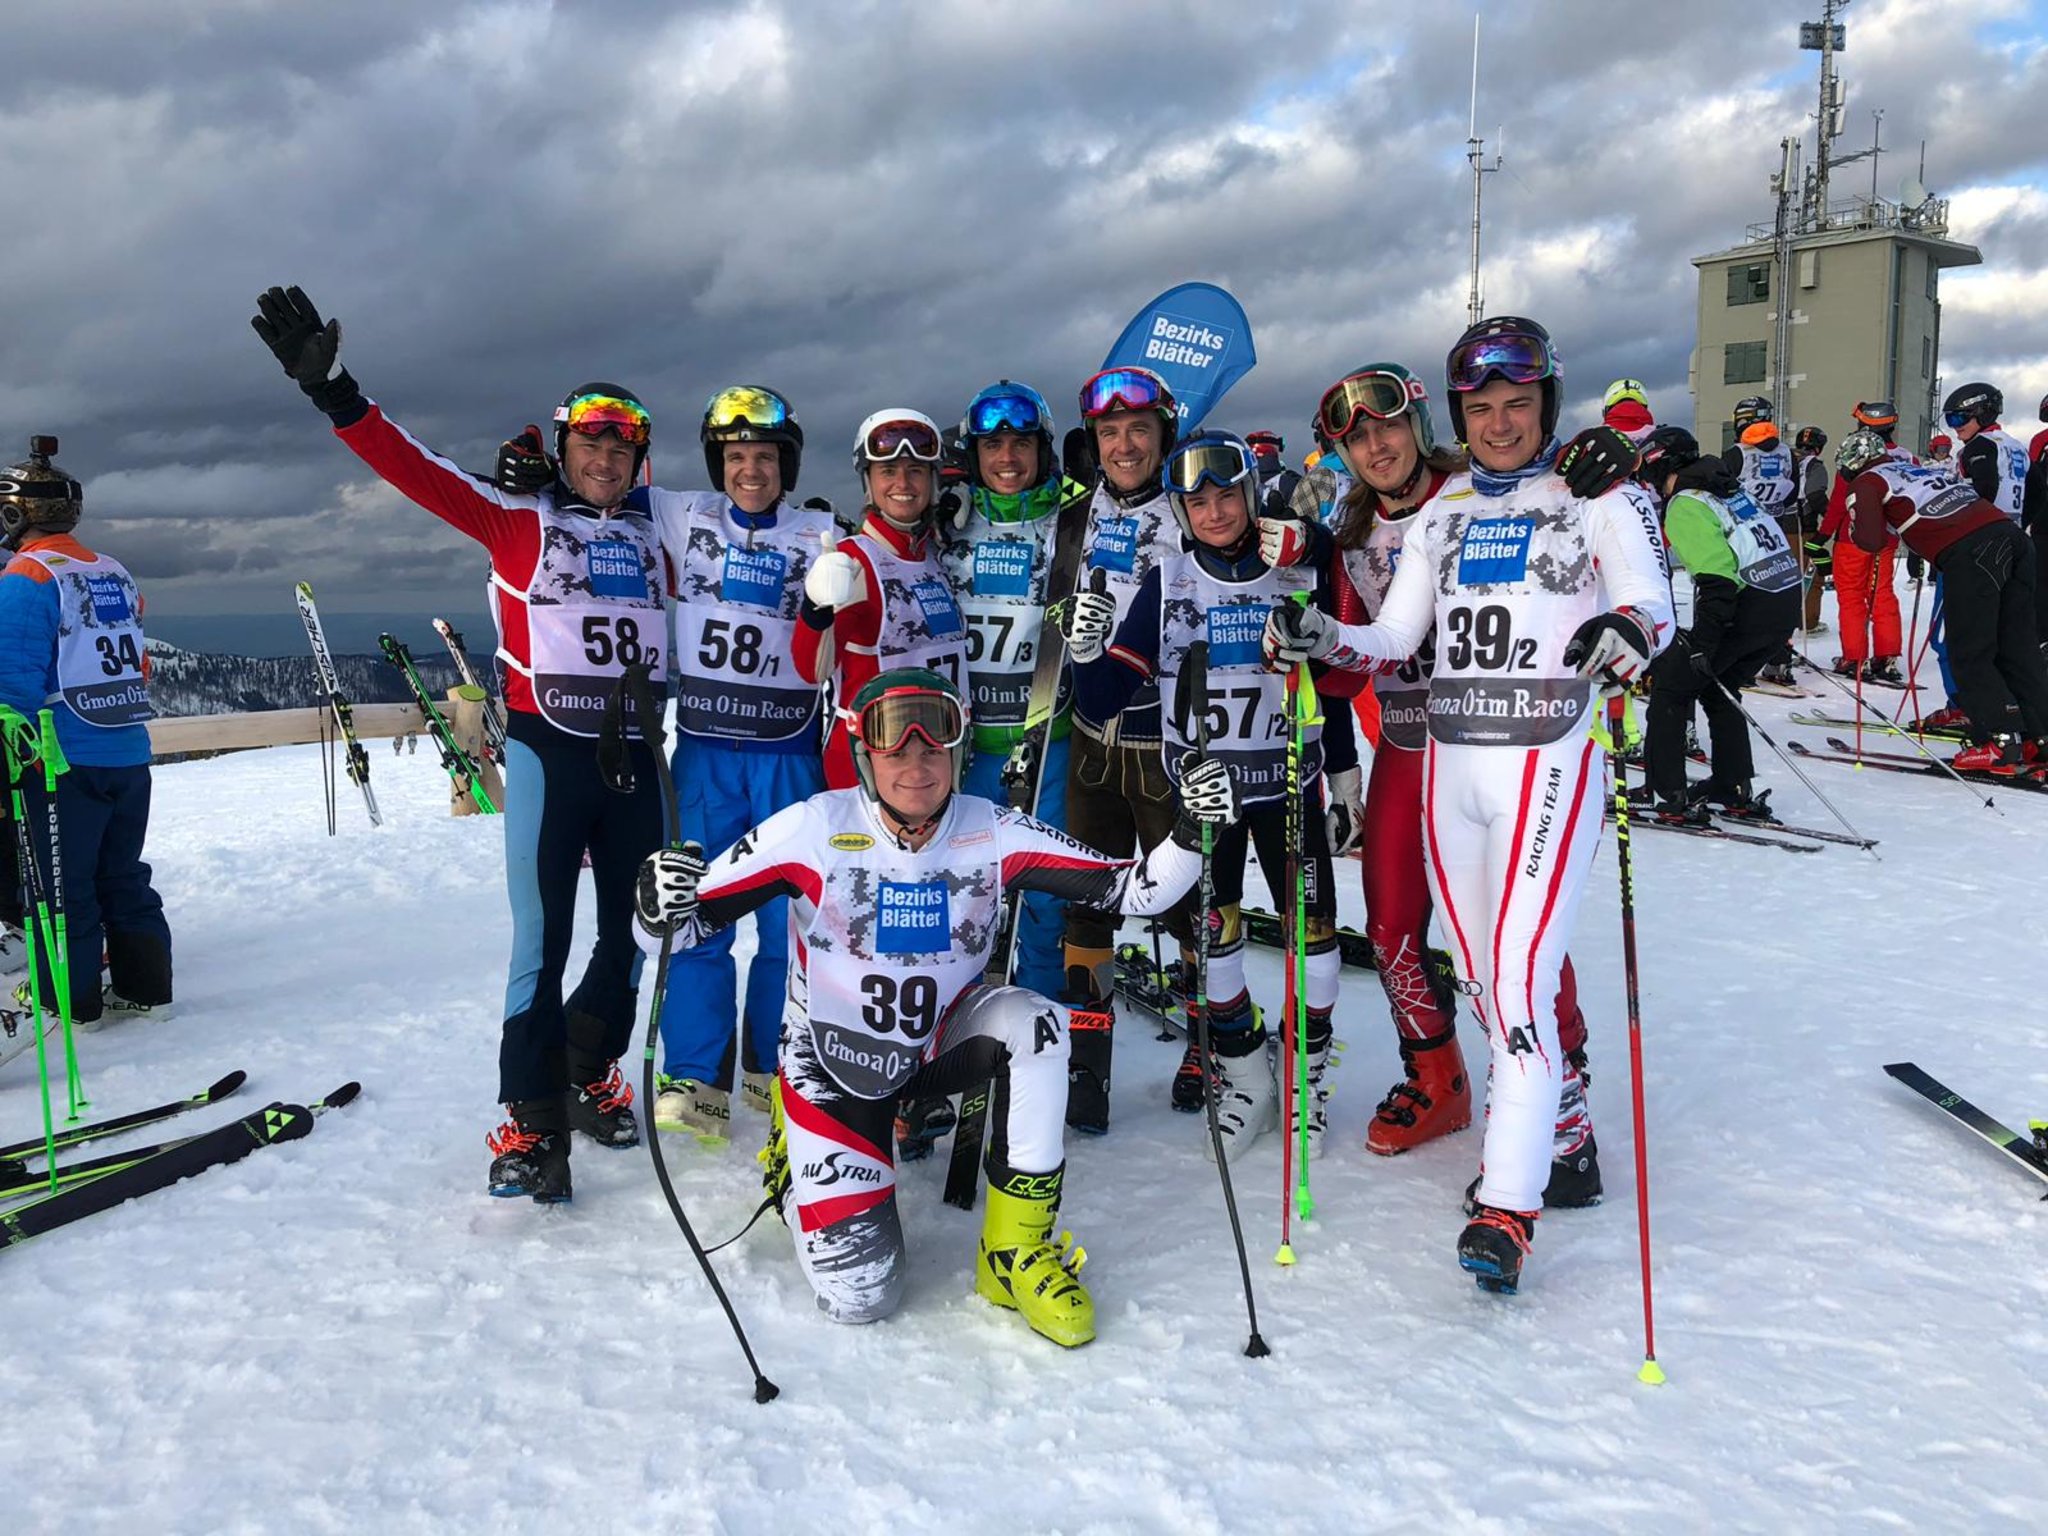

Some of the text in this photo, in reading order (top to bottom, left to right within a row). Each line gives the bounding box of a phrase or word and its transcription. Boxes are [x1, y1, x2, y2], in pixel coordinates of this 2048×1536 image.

[1153, 317, 1224, 350] Bezirks
[1146, 339, 1213, 368] Blätter
[1561, 445, 1579, 473] LEKI
[1467, 523, 1527, 541] Bezirks
[591, 543, 637, 562] Bezirks
[728, 550, 782, 571] Bezirks
[978, 545, 1028, 560] Bezirks
[1464, 542, 1520, 560] Blätter
[592, 559, 639, 577] Blätter
[727, 567, 776, 587] Blätter
[976, 560, 1024, 576] Blätter
[1211, 609, 1266, 626] Bezirks
[582, 616, 659, 669] 58/2
[699, 619, 780, 677] 58/1
[1447, 605, 1538, 672] 39/2
[96, 634, 141, 677] 34
[1206, 687, 1287, 740] 57/2
[1287, 741, 1297, 795] LEKI
[1615, 778, 1629, 841] LEKI
[1526, 767, 1562, 878] RACING TEAM
[48, 802, 62, 908] KOMPERDELL
[662, 851, 705, 867] ENERGIA
[883, 886, 943, 906] Bezirks
[882, 909, 940, 928] Blätter
[741, 1078, 771, 1101] HEA
[694, 1101, 731, 1121] HEAD
[961, 1094, 985, 1118] GS
[801, 1151, 882, 1185] AUSTRIA
[1005, 1172, 1062, 1194] RC4
